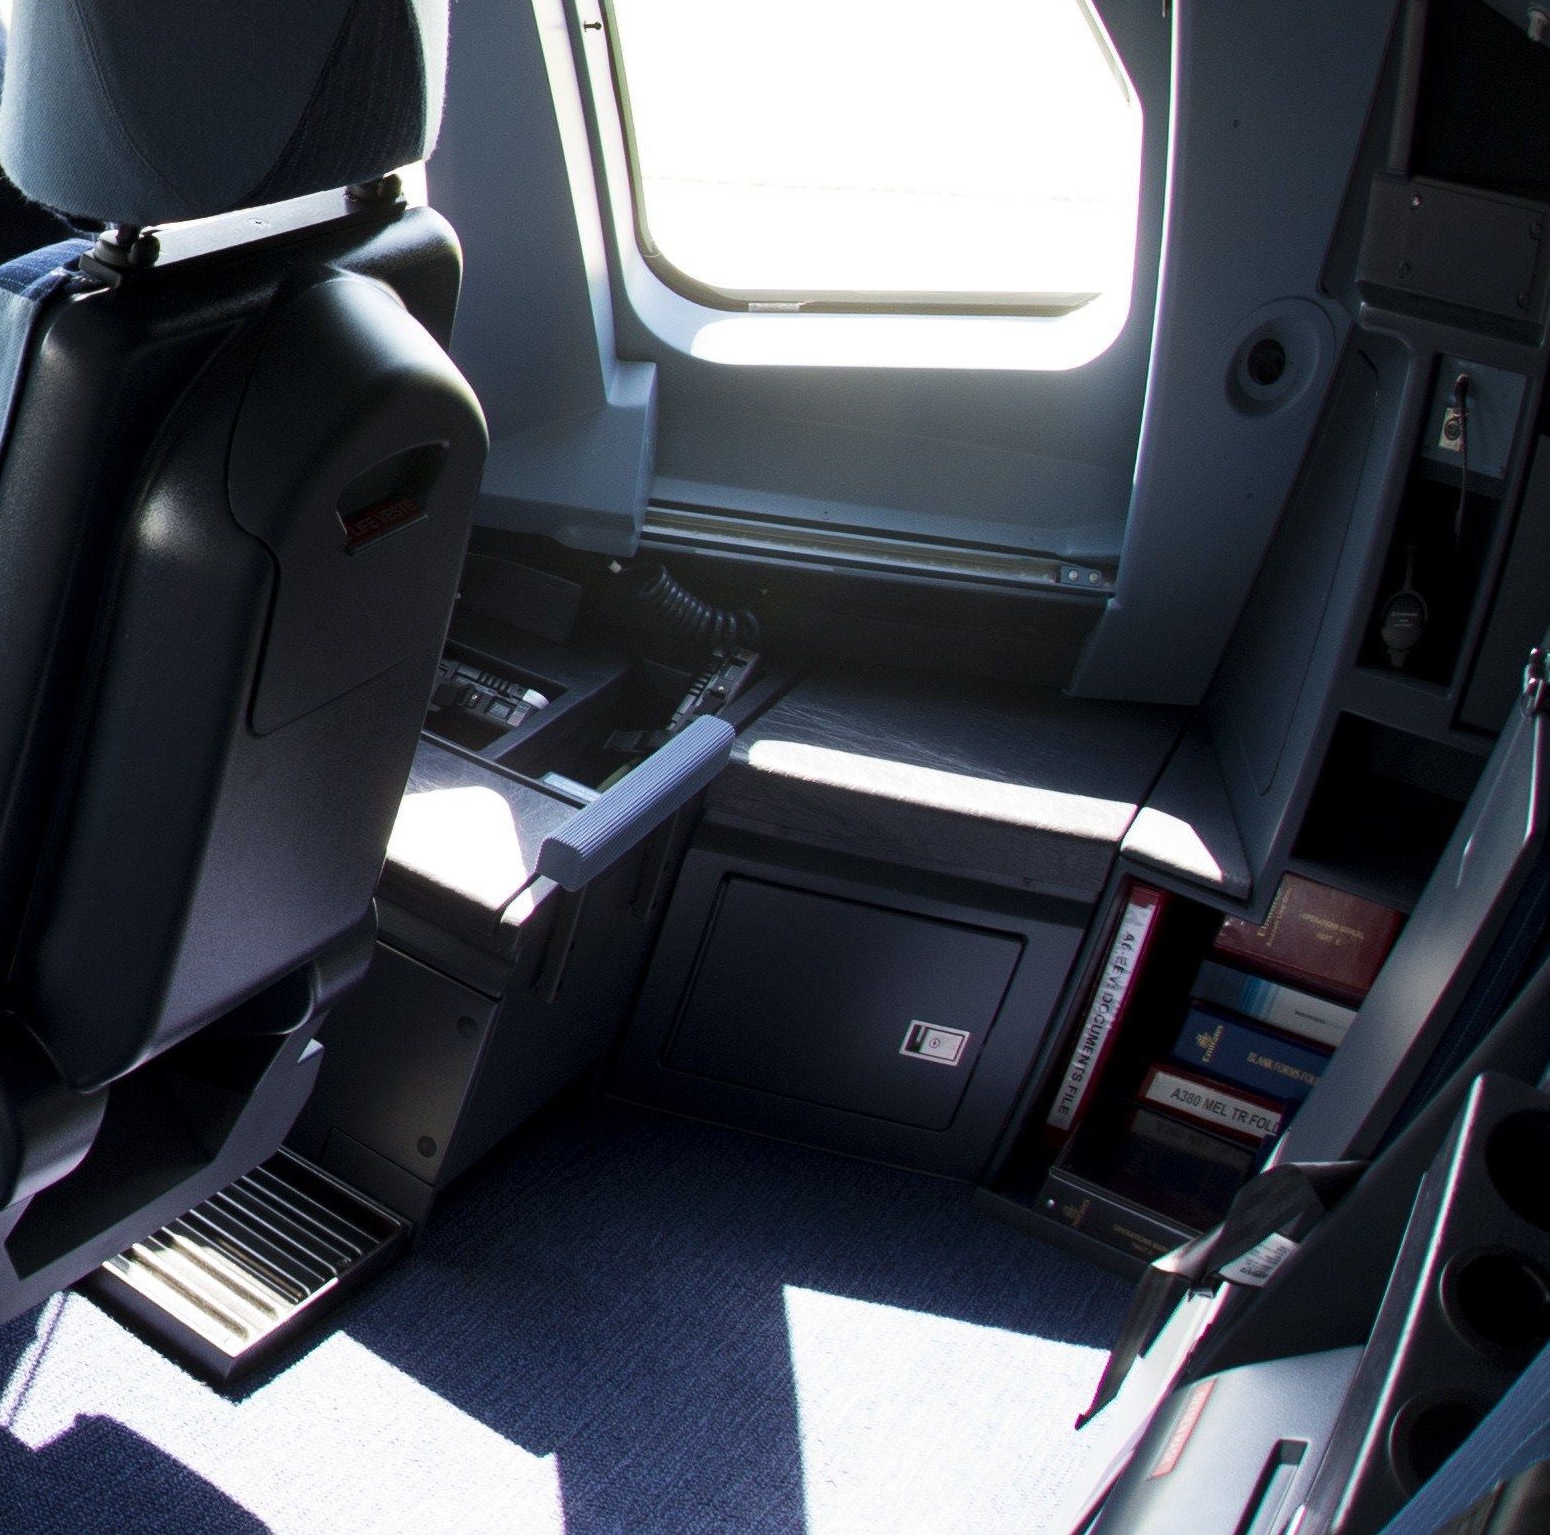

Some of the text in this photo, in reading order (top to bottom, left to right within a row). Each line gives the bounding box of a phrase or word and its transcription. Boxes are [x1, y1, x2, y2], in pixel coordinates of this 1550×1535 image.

[350, 516, 380, 537] LIFE
[1058, 991, 1113, 1116] DOCUMENTS FILE
[1170, 1088, 1249, 1124] A380 MEL TR
